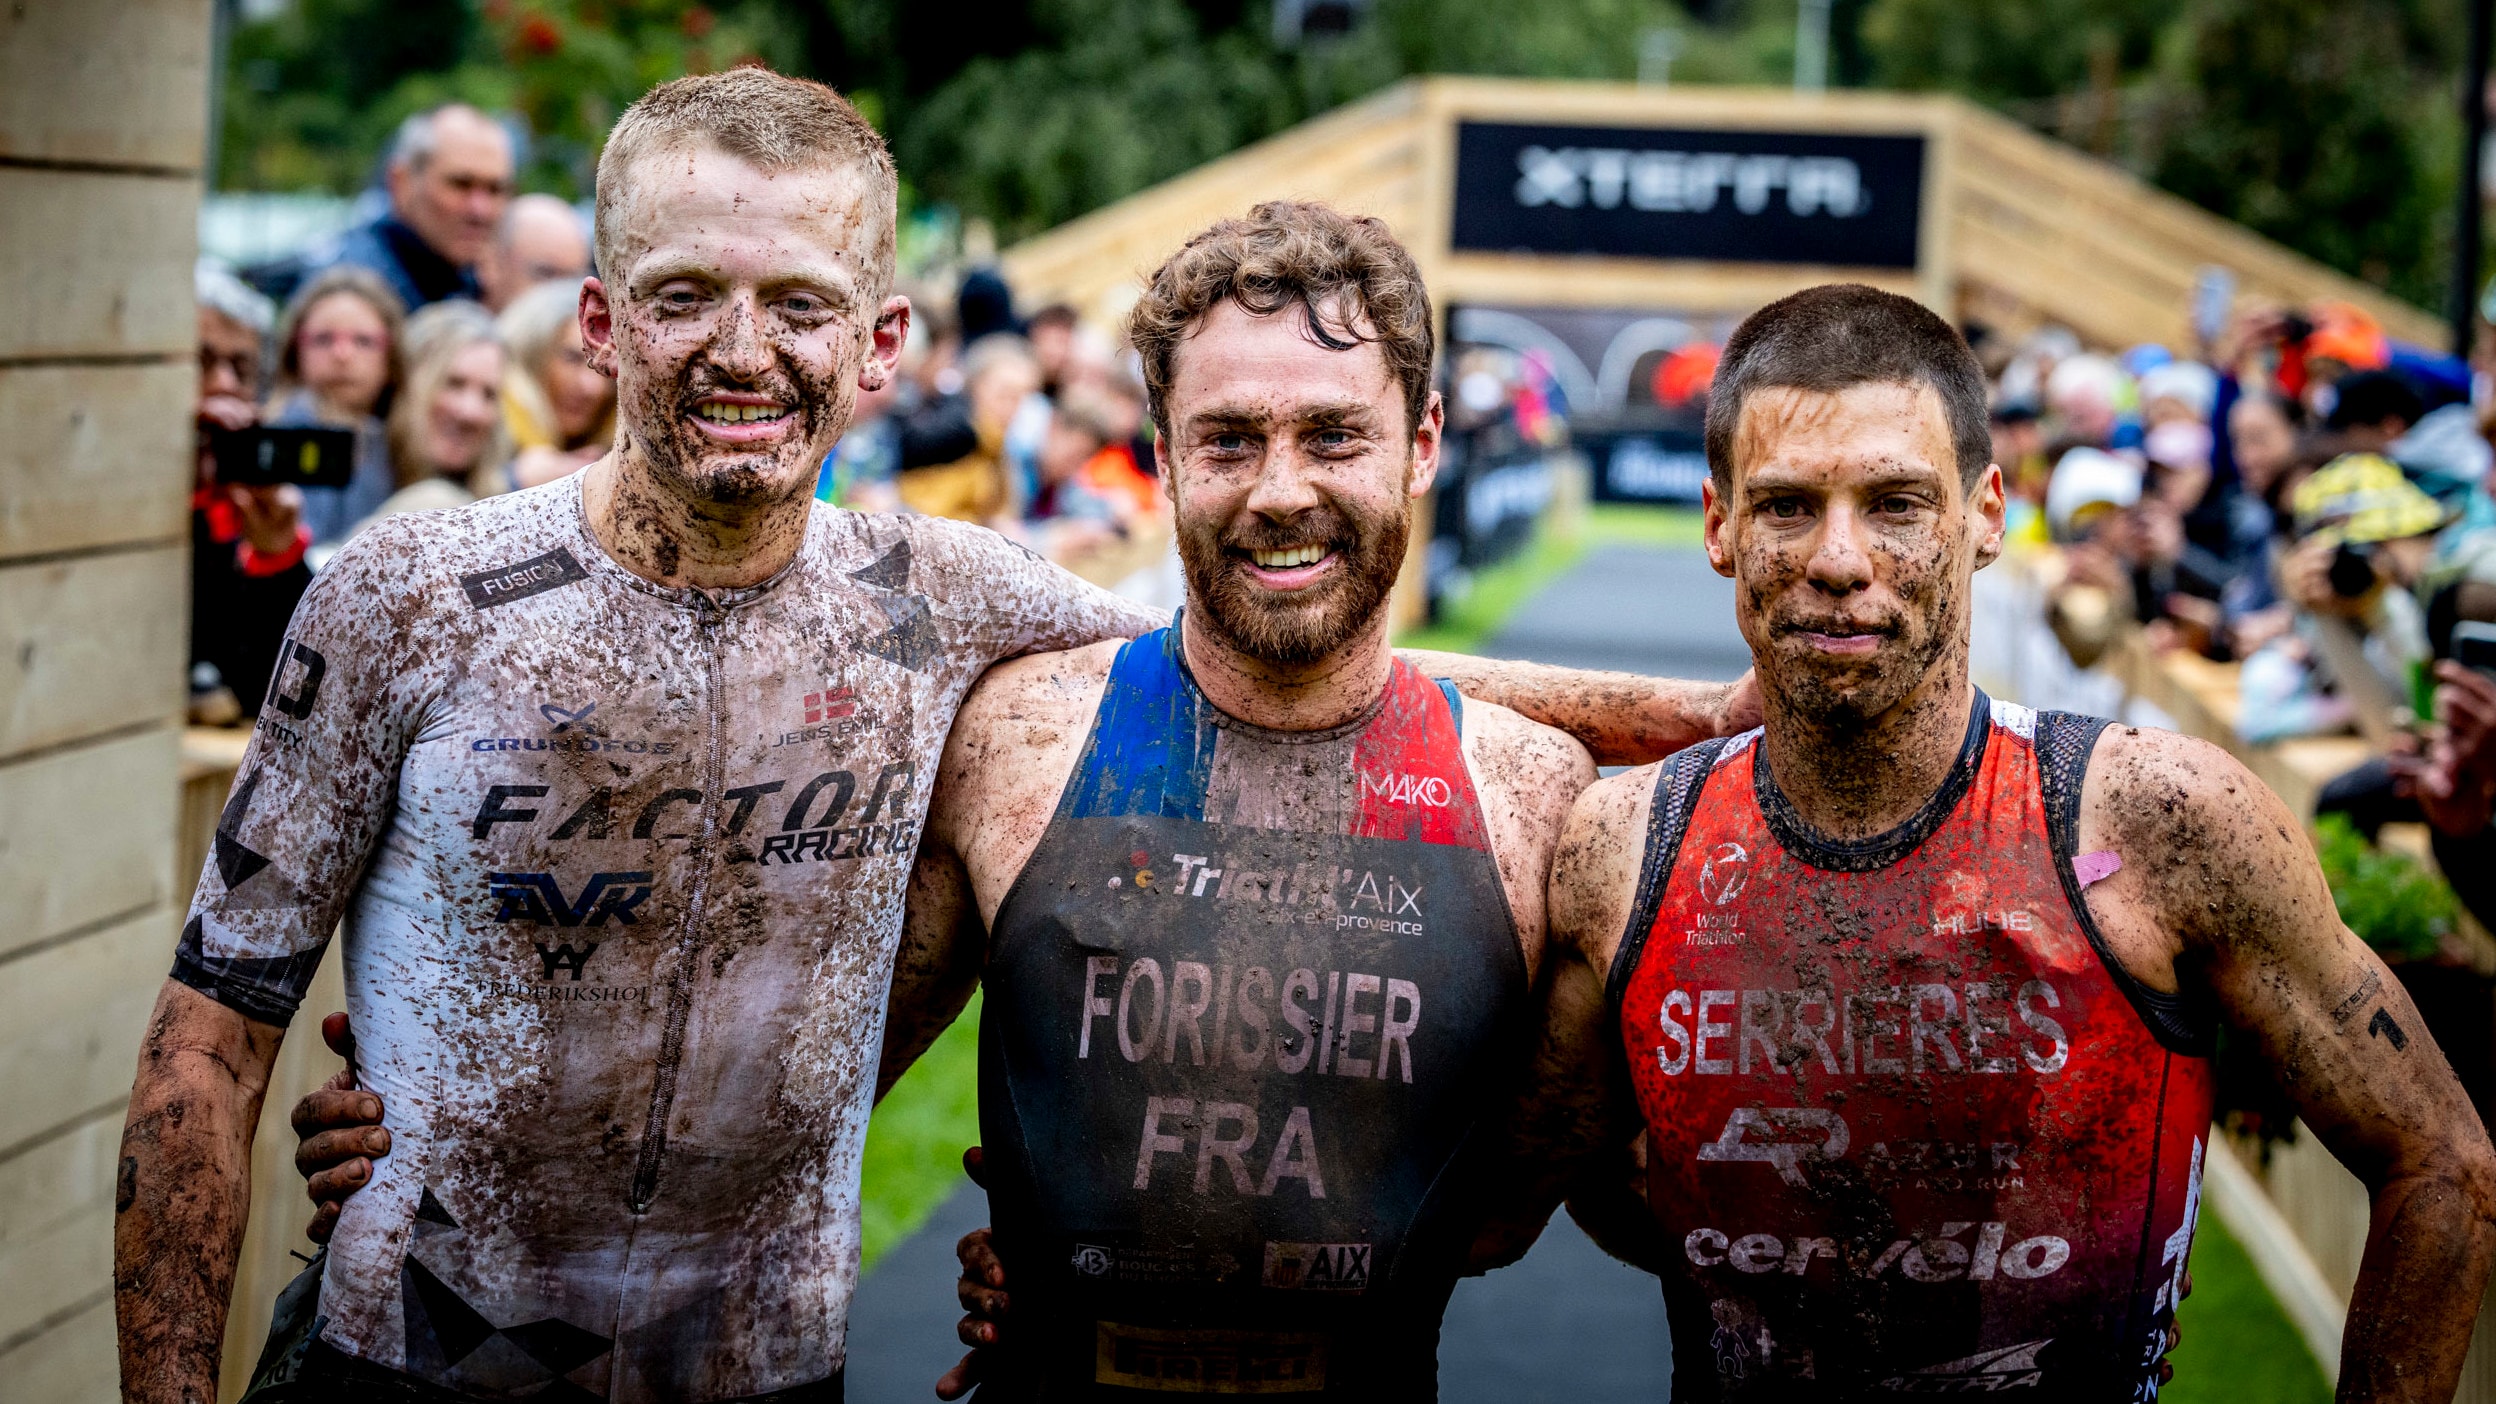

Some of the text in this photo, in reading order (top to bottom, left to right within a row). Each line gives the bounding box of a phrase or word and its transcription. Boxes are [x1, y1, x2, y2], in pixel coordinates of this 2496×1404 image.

[481, 558, 565, 596] FUSION
[471, 738, 672, 755] GRUNDFOS
[772, 725, 831, 748] JENS
[473, 761, 915, 841] FACTOR
[1360, 770, 1452, 808] MAKO
[757, 820, 915, 866] RACING
[1685, 930, 1746, 946] Triathlon
[1696, 912, 1739, 928] World
[1078, 955, 1421, 1084] FORISSIER
[2367, 1006, 2410, 1053] 1
[1132, 1096, 1327, 1199] FRA
[1306, 1246, 1369, 1280] AIX
